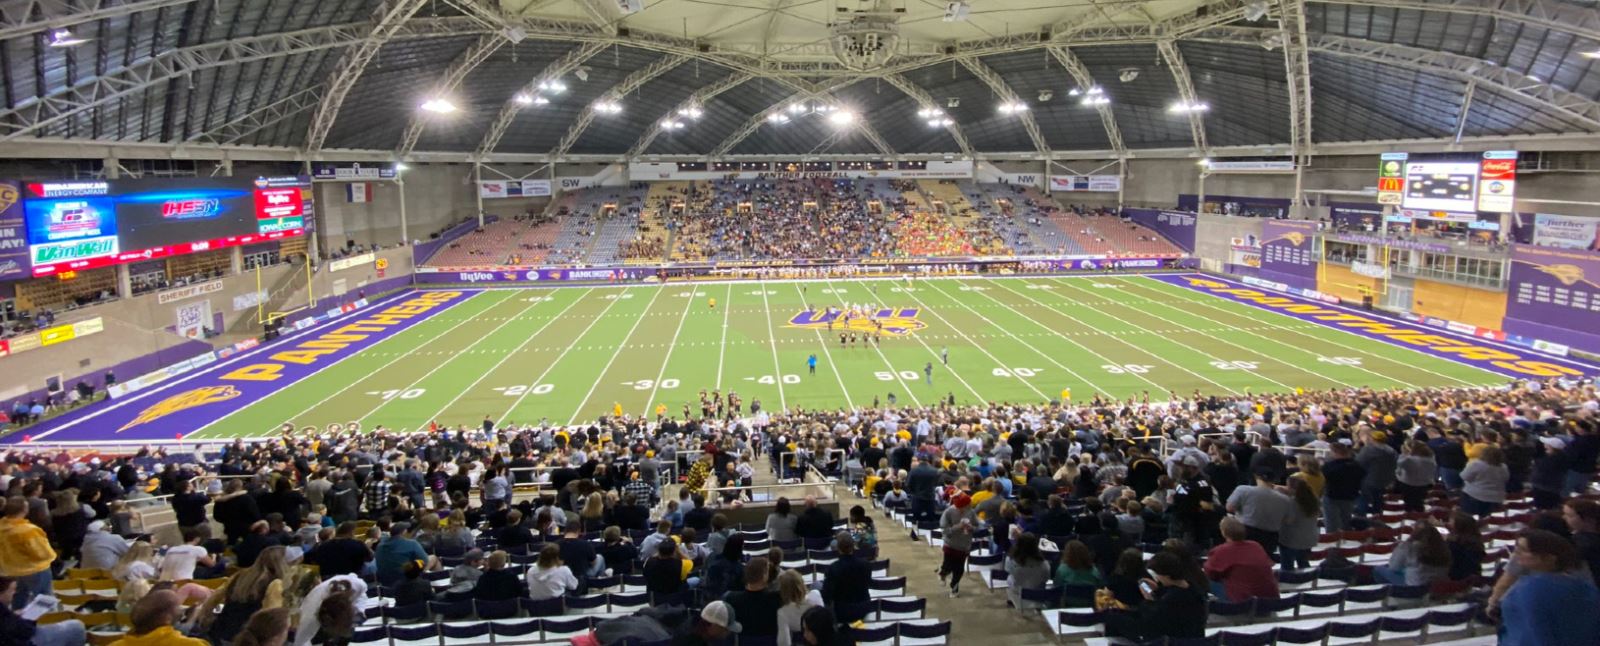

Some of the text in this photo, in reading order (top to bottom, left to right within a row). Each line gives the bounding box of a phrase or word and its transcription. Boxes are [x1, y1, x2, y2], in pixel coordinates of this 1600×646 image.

[562, 179, 580, 188] SW
[1017, 175, 1036, 184] NW
[160, 281, 222, 302] SHERIFF FIELD
[219, 290, 463, 381] PANTHERS
[1212, 287, 1584, 377] PANTHERS
[992, 367, 1036, 378] 40
[1100, 363, 1150, 374] 30
[757, 374, 801, 385] 40
[874, 371, 920, 381] 50
[632, 378, 681, 390] 30
[379, 388, 427, 400] 10
[502, 384, 555, 396] 20
